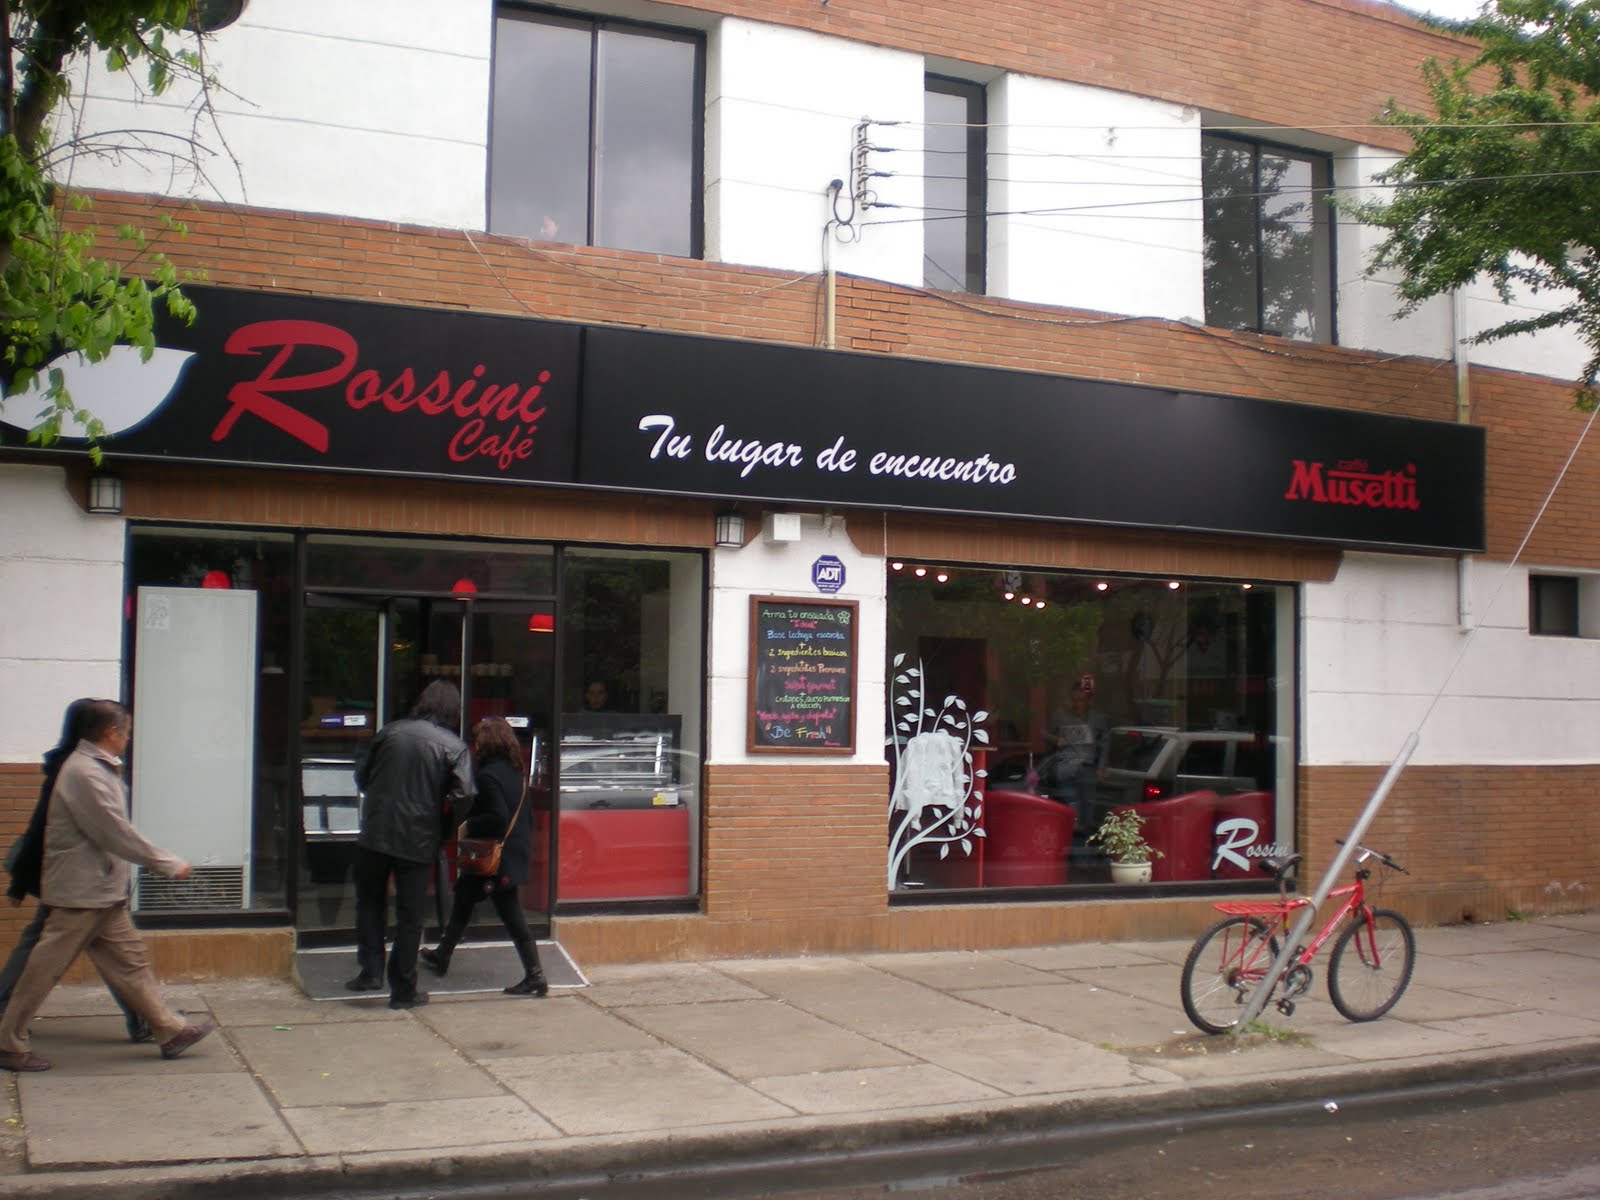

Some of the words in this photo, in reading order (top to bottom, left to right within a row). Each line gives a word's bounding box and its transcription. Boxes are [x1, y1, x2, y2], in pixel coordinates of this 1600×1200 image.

[211, 319, 551, 454] Rossini
[448, 418, 537, 470] Café
[638, 414, 691, 459] Tu
[704, 424, 803, 478] lugar
[816, 435, 857, 472] de
[869, 451, 1017, 485] encuentro
[1283, 460, 1421, 511] Musetti
[817, 567, 841, 582] ADT
[769, 648, 775, 656] 2
